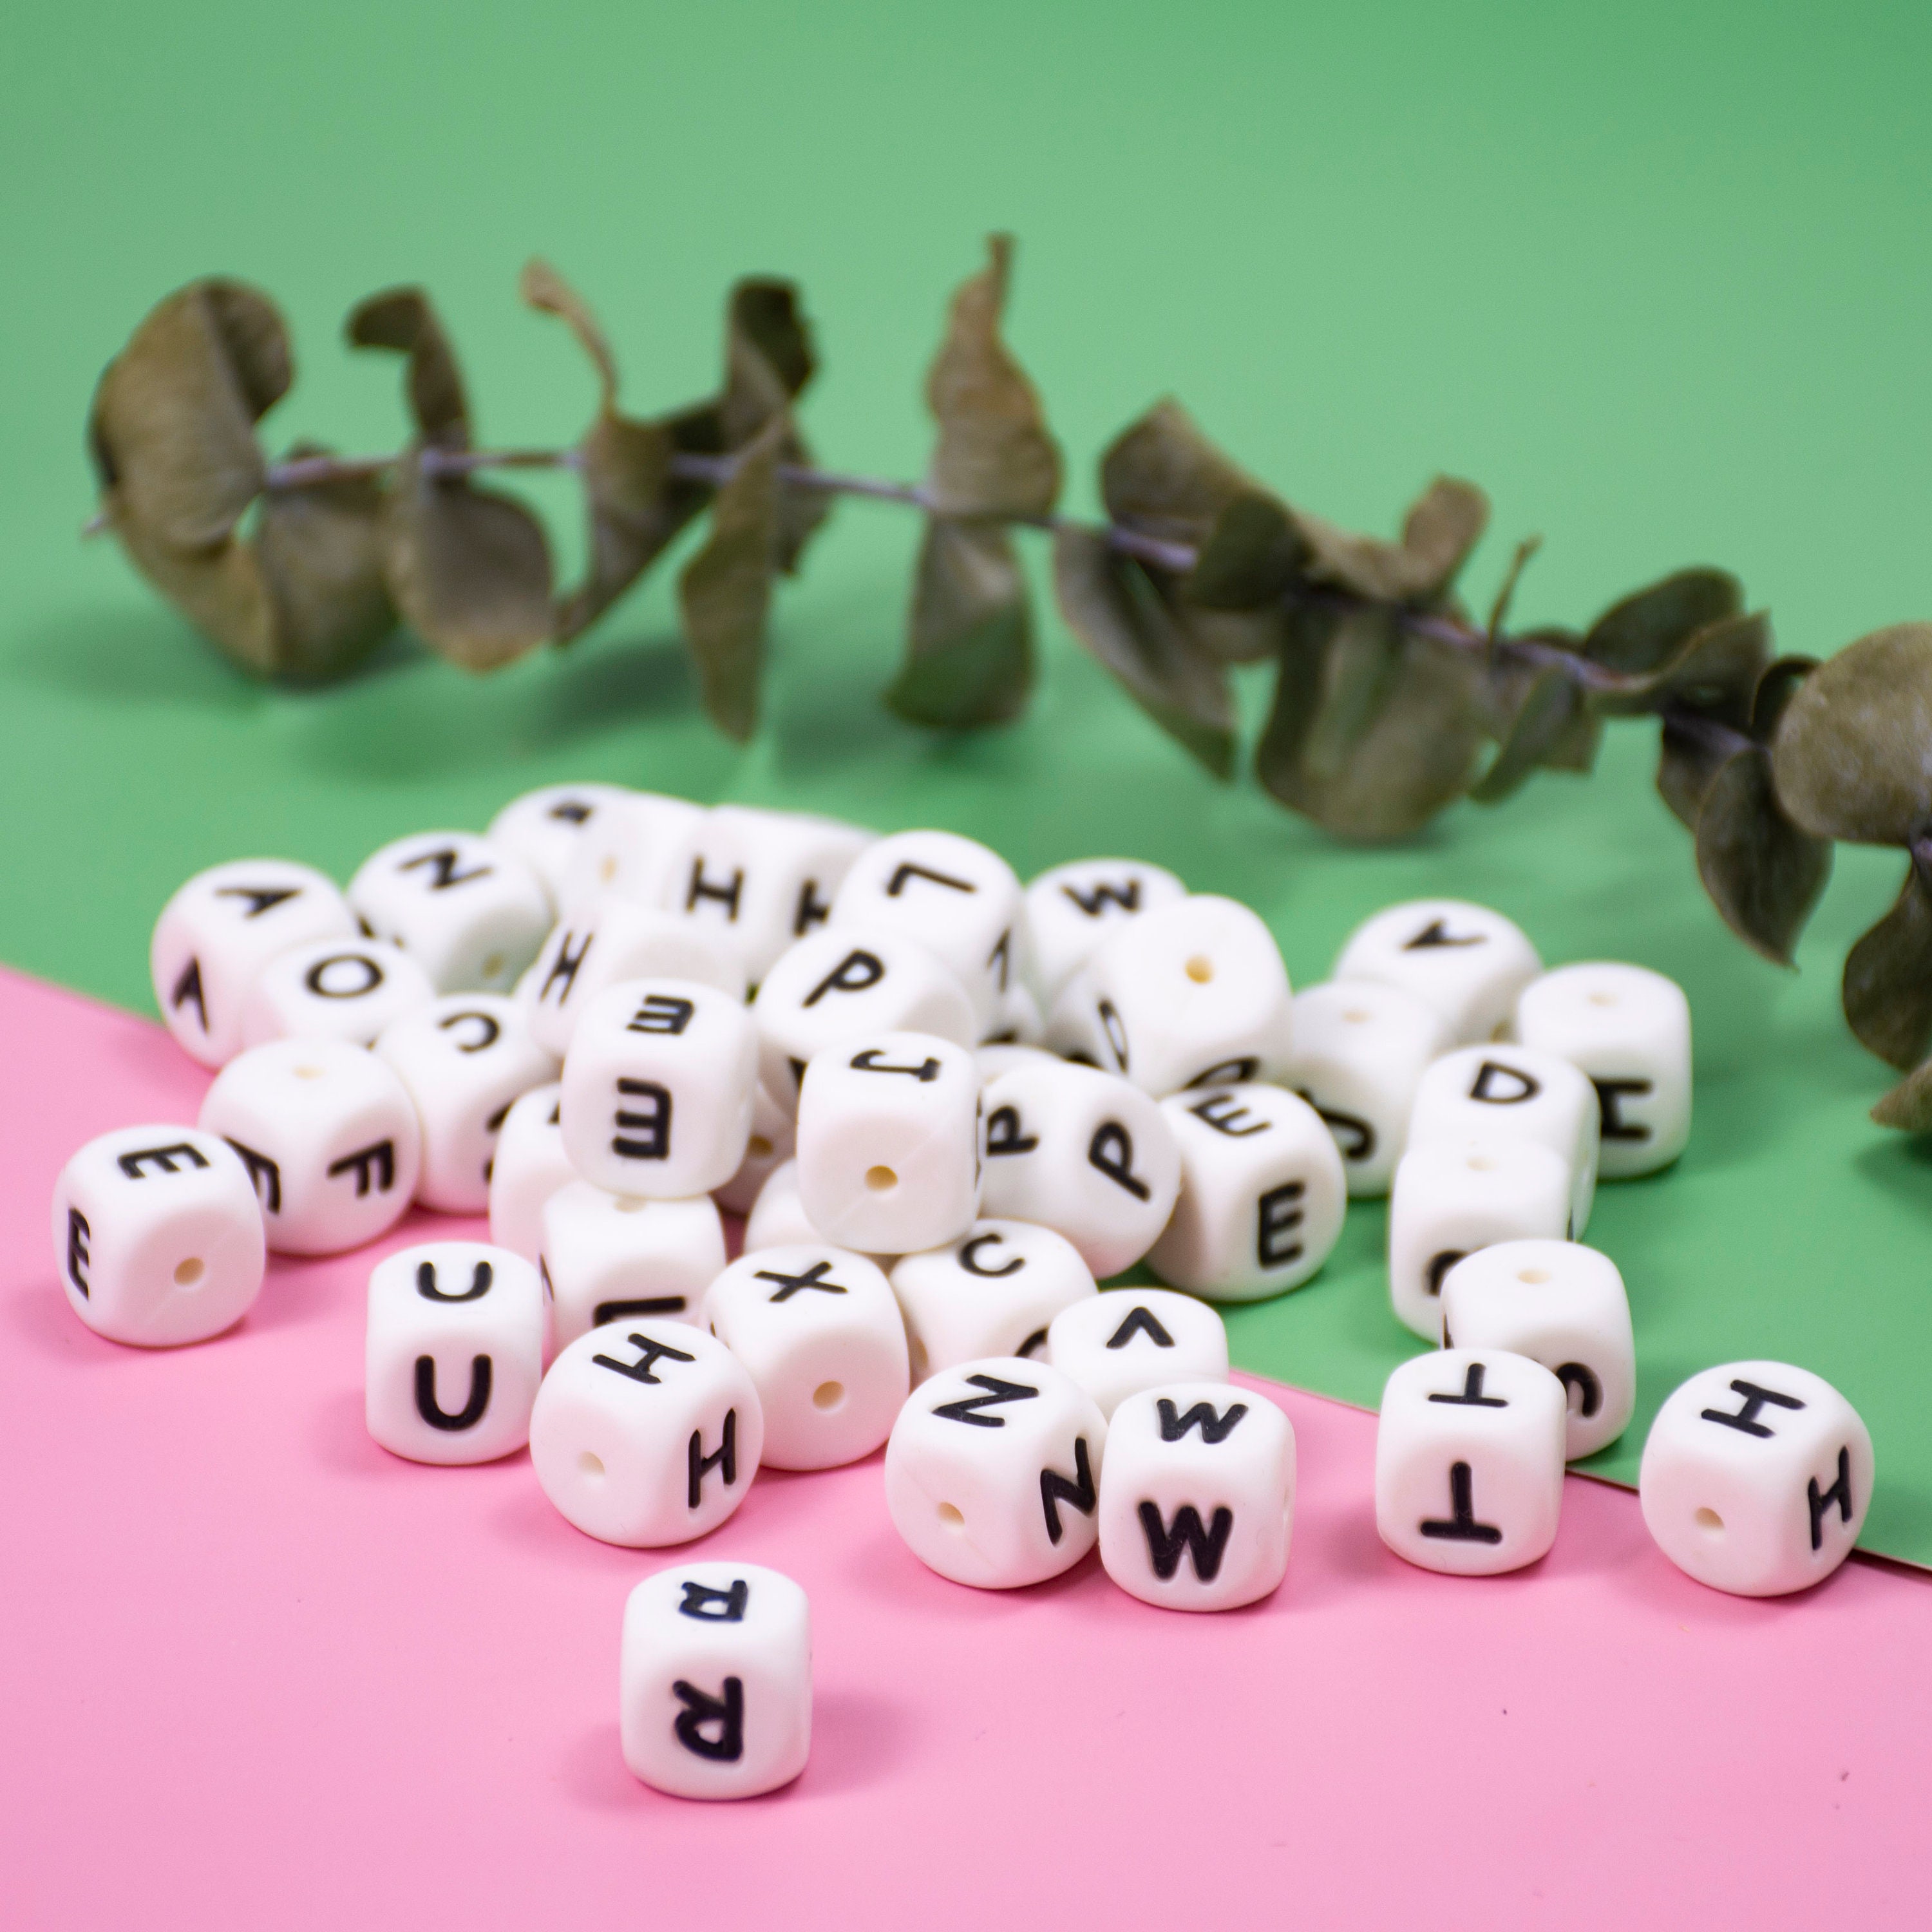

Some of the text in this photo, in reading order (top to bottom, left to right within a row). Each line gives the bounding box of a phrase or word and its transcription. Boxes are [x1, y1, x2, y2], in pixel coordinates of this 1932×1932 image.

[687, 860, 743, 920] H
[305, 956, 383, 998] O
[539, 931, 592, 1007] H
[804, 950, 884, 1007] P
[439, 1012, 501, 1054] C
[628, 996, 694, 1035] E
[850, 1050, 939, 1082] J
[1470, 1061, 1540, 1104] D
[612, 1079, 672, 1160] E
[1184, 1088, 1275, 1140] E
[118, 1144, 207, 1179] E
[330, 1141, 395, 1195] F
[1088, 1121, 1150, 1200] P
[1255, 1180, 1305, 1271] E
[70, 1210, 90, 1297] E
[958, 1233, 1025, 1277] C
[417, 1262, 492, 1302] U
[755, 1262, 848, 1303] X
[592, 1334, 696, 1384] H
[1428, 1363, 1508, 1407] T
[415, 1355, 491, 1432] U
[1701, 1379, 1805, 1438] H
[1157, 1399, 1248, 1444] W
[688, 1408, 736, 1508] H
[1420, 1462, 1502, 1544] T
[1807, 1446, 1853, 1551] H
[1138, 1501, 1233, 1582] W
[680, 1580, 748, 1620] R
[673, 1677, 744, 1763] R
